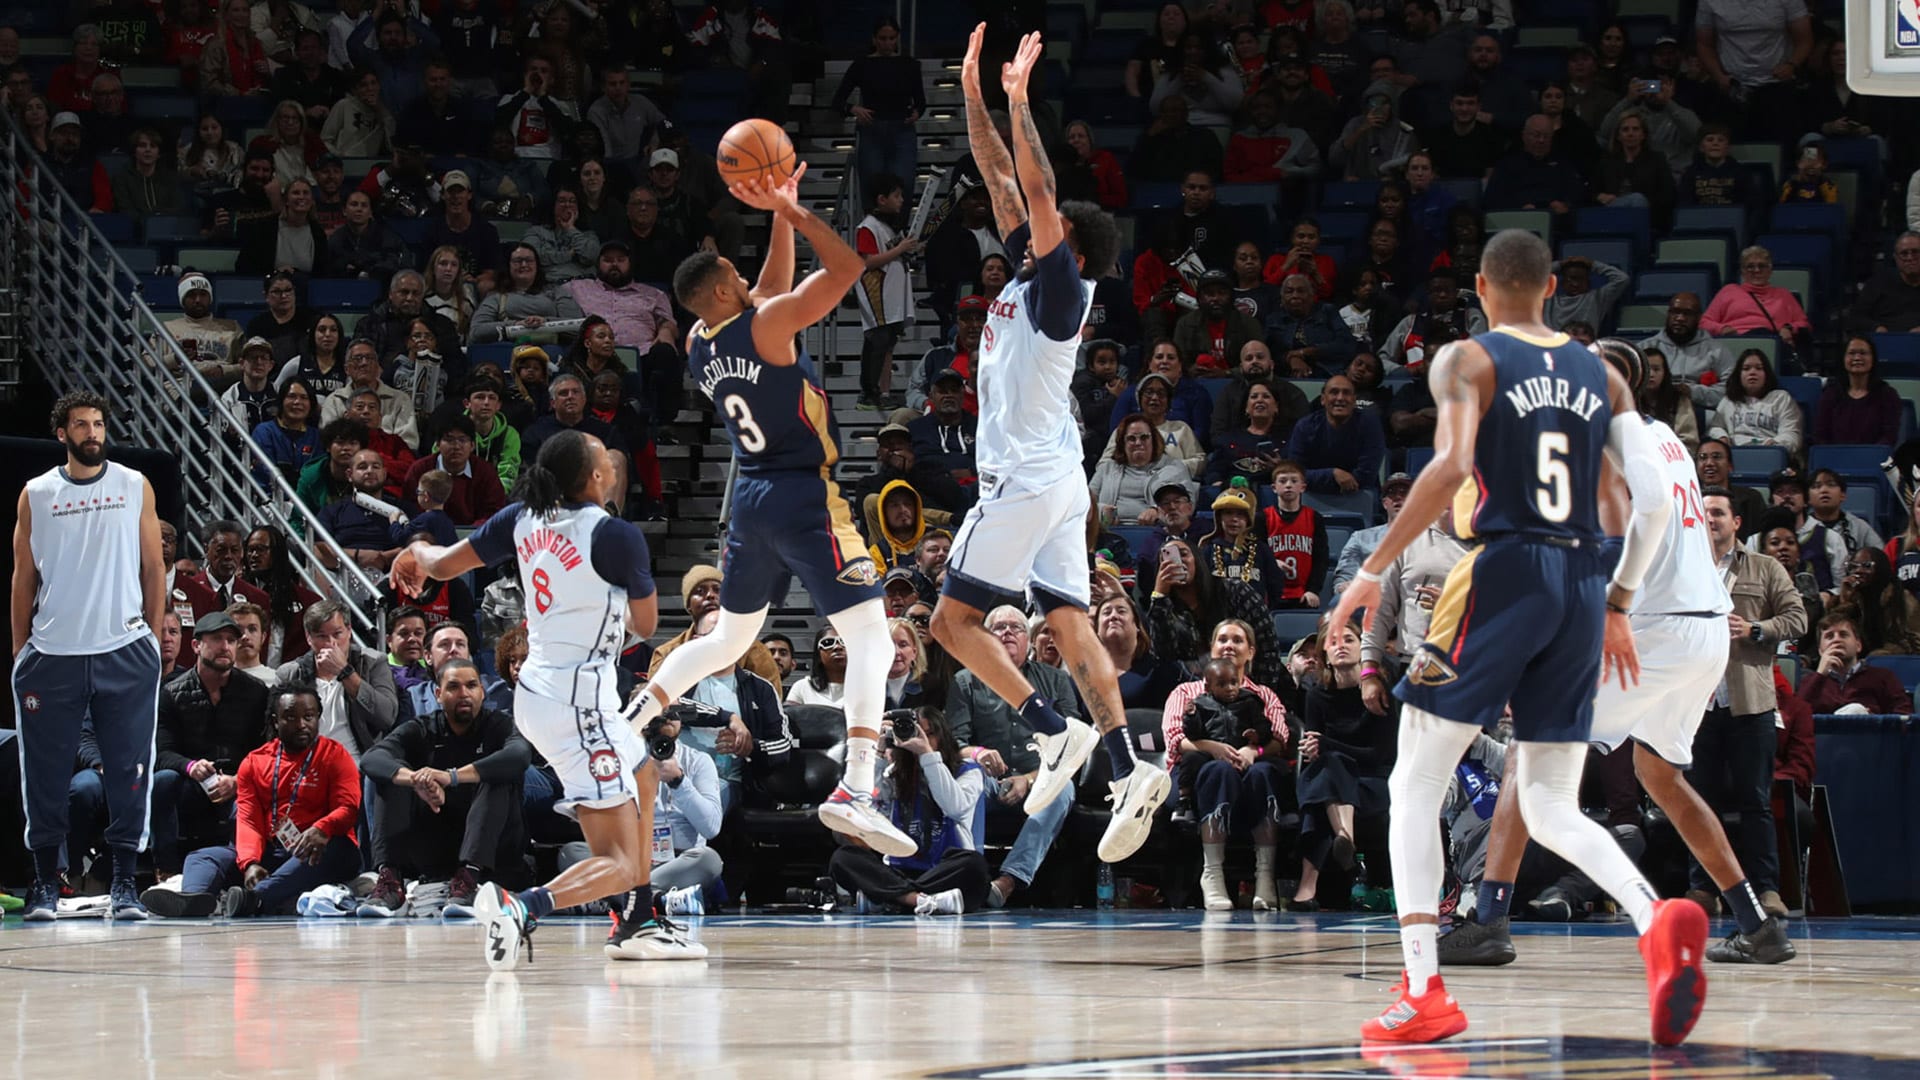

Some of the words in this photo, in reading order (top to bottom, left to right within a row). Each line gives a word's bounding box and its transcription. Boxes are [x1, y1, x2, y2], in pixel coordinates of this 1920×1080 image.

[1900, 30, 1917, 43] NBA
[1194, 227, 1208, 249] P
[984, 324, 994, 352] 9
[699, 356, 762, 401] McCOLLUM
[1505, 375, 1602, 421] MURRAY
[724, 393, 767, 453] 3
[1536, 431, 1572, 522] 5
[52, 507, 94, 518] WASHINGTON
[95, 503, 126, 513] WIZARDS
[1673, 478, 1704, 528] 20
[1267, 533, 1313, 555] PELICANS
[532, 568, 553, 615] 8
